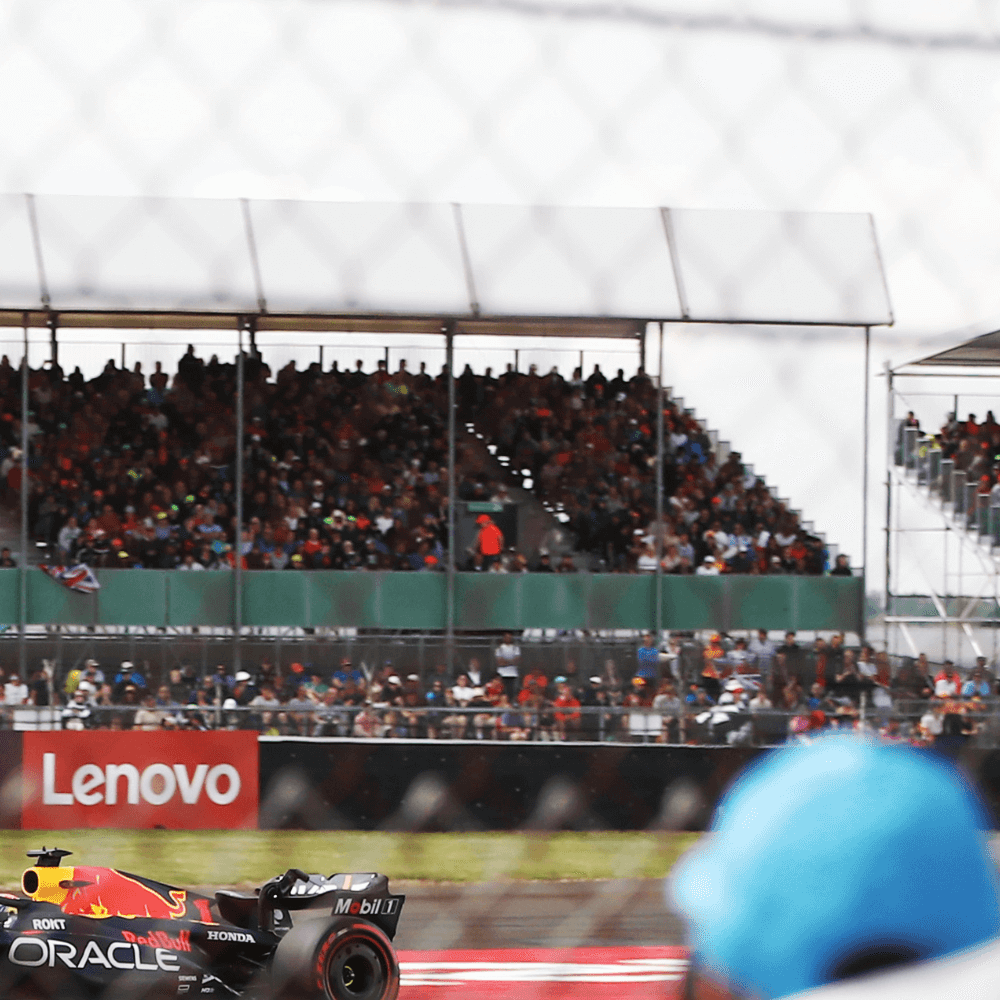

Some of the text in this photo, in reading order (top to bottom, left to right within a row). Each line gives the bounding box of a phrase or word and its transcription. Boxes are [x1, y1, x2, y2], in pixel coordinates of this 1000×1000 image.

[43, 752, 241, 805] Lenovo
[334, 898, 381, 914] Mobil
[206, 930, 256, 943] HONDA
[8, 936, 181, 972] ORACLE
